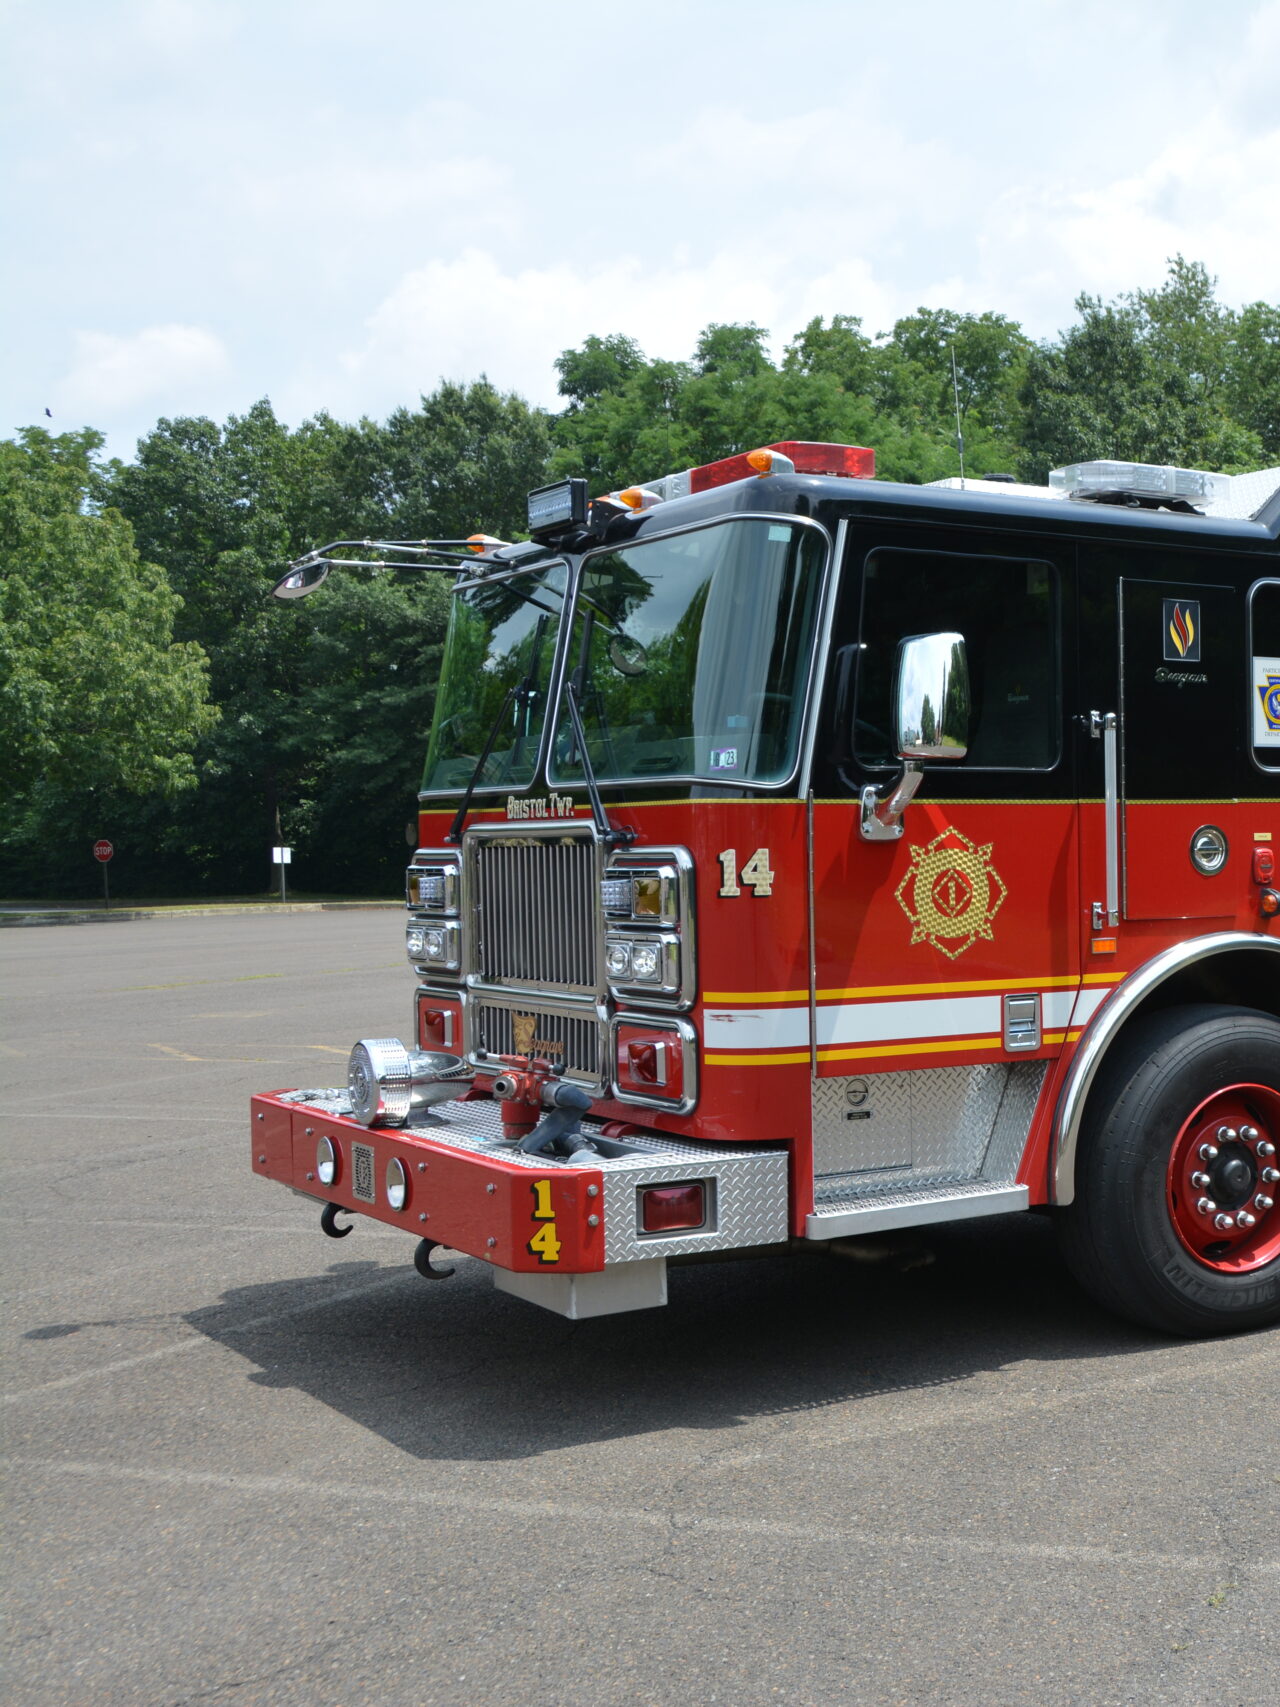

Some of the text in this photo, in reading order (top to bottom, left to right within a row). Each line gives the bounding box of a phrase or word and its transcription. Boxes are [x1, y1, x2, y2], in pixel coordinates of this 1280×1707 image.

[726, 750, 735, 766] 23
[96, 847, 112, 856] STOP
[718, 848, 775, 898] 14
